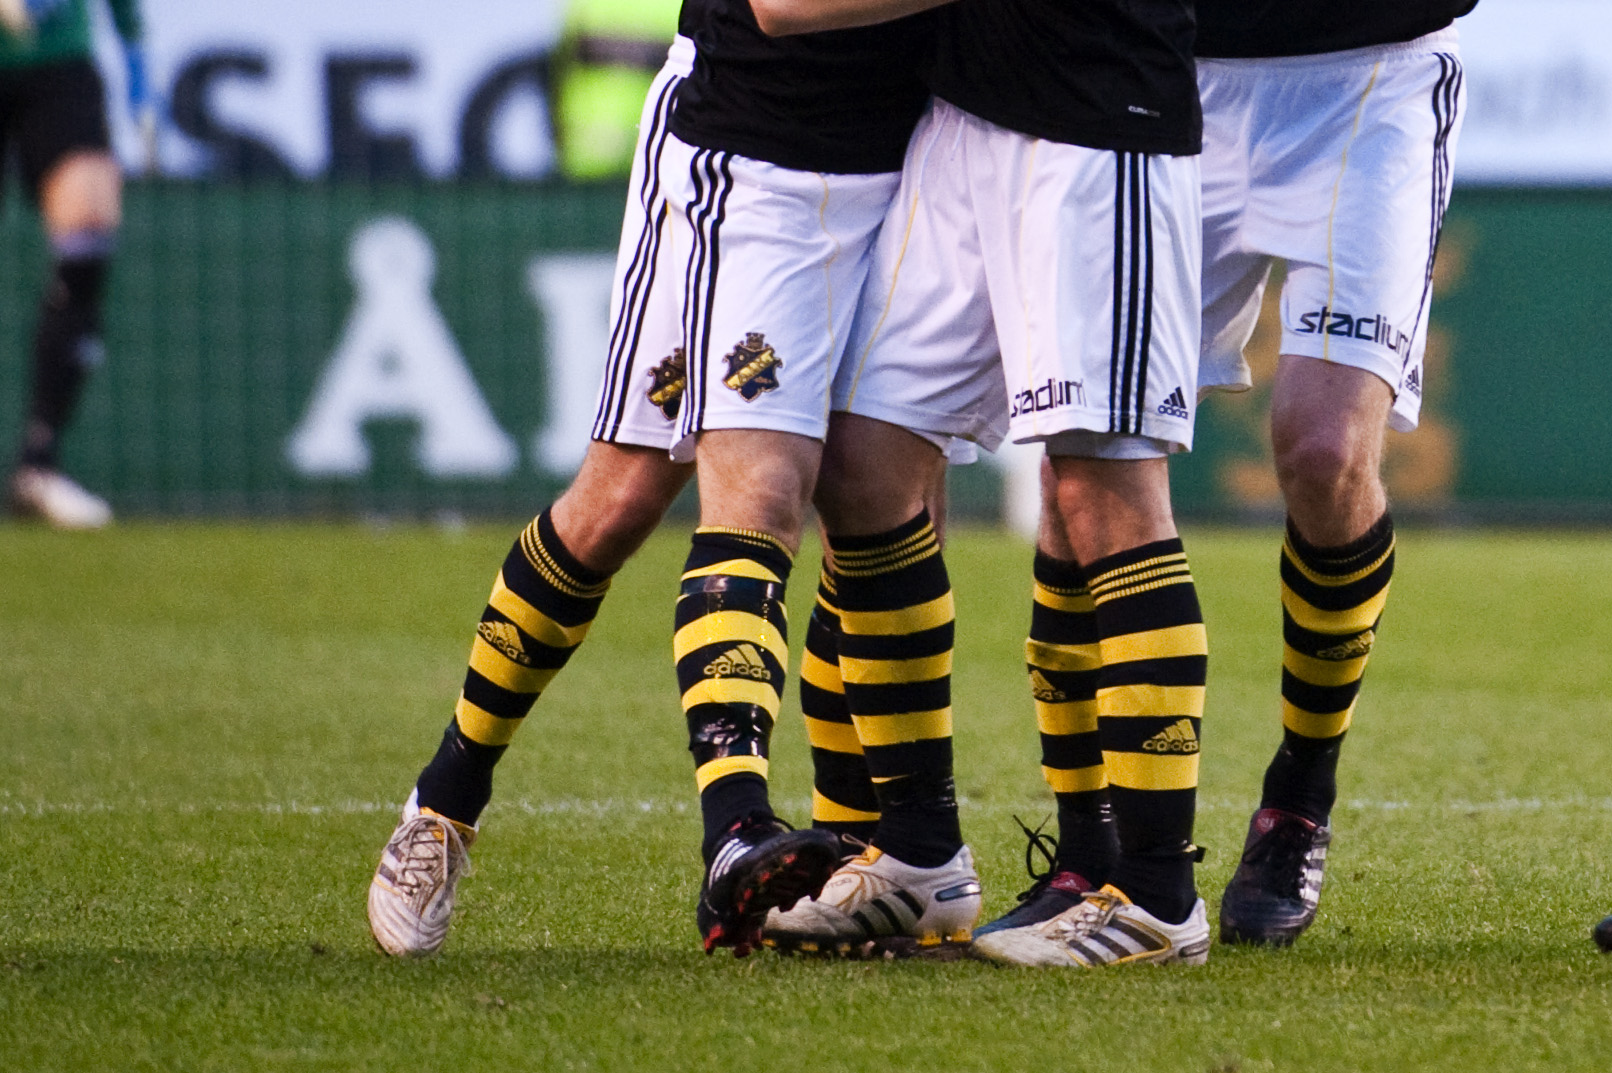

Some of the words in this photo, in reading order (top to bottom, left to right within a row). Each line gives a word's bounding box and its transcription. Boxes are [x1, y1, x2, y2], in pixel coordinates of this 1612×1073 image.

[477, 622, 531, 665] adidas
[703, 663, 771, 680] adidas
[1142, 738, 1198, 751] adidas
